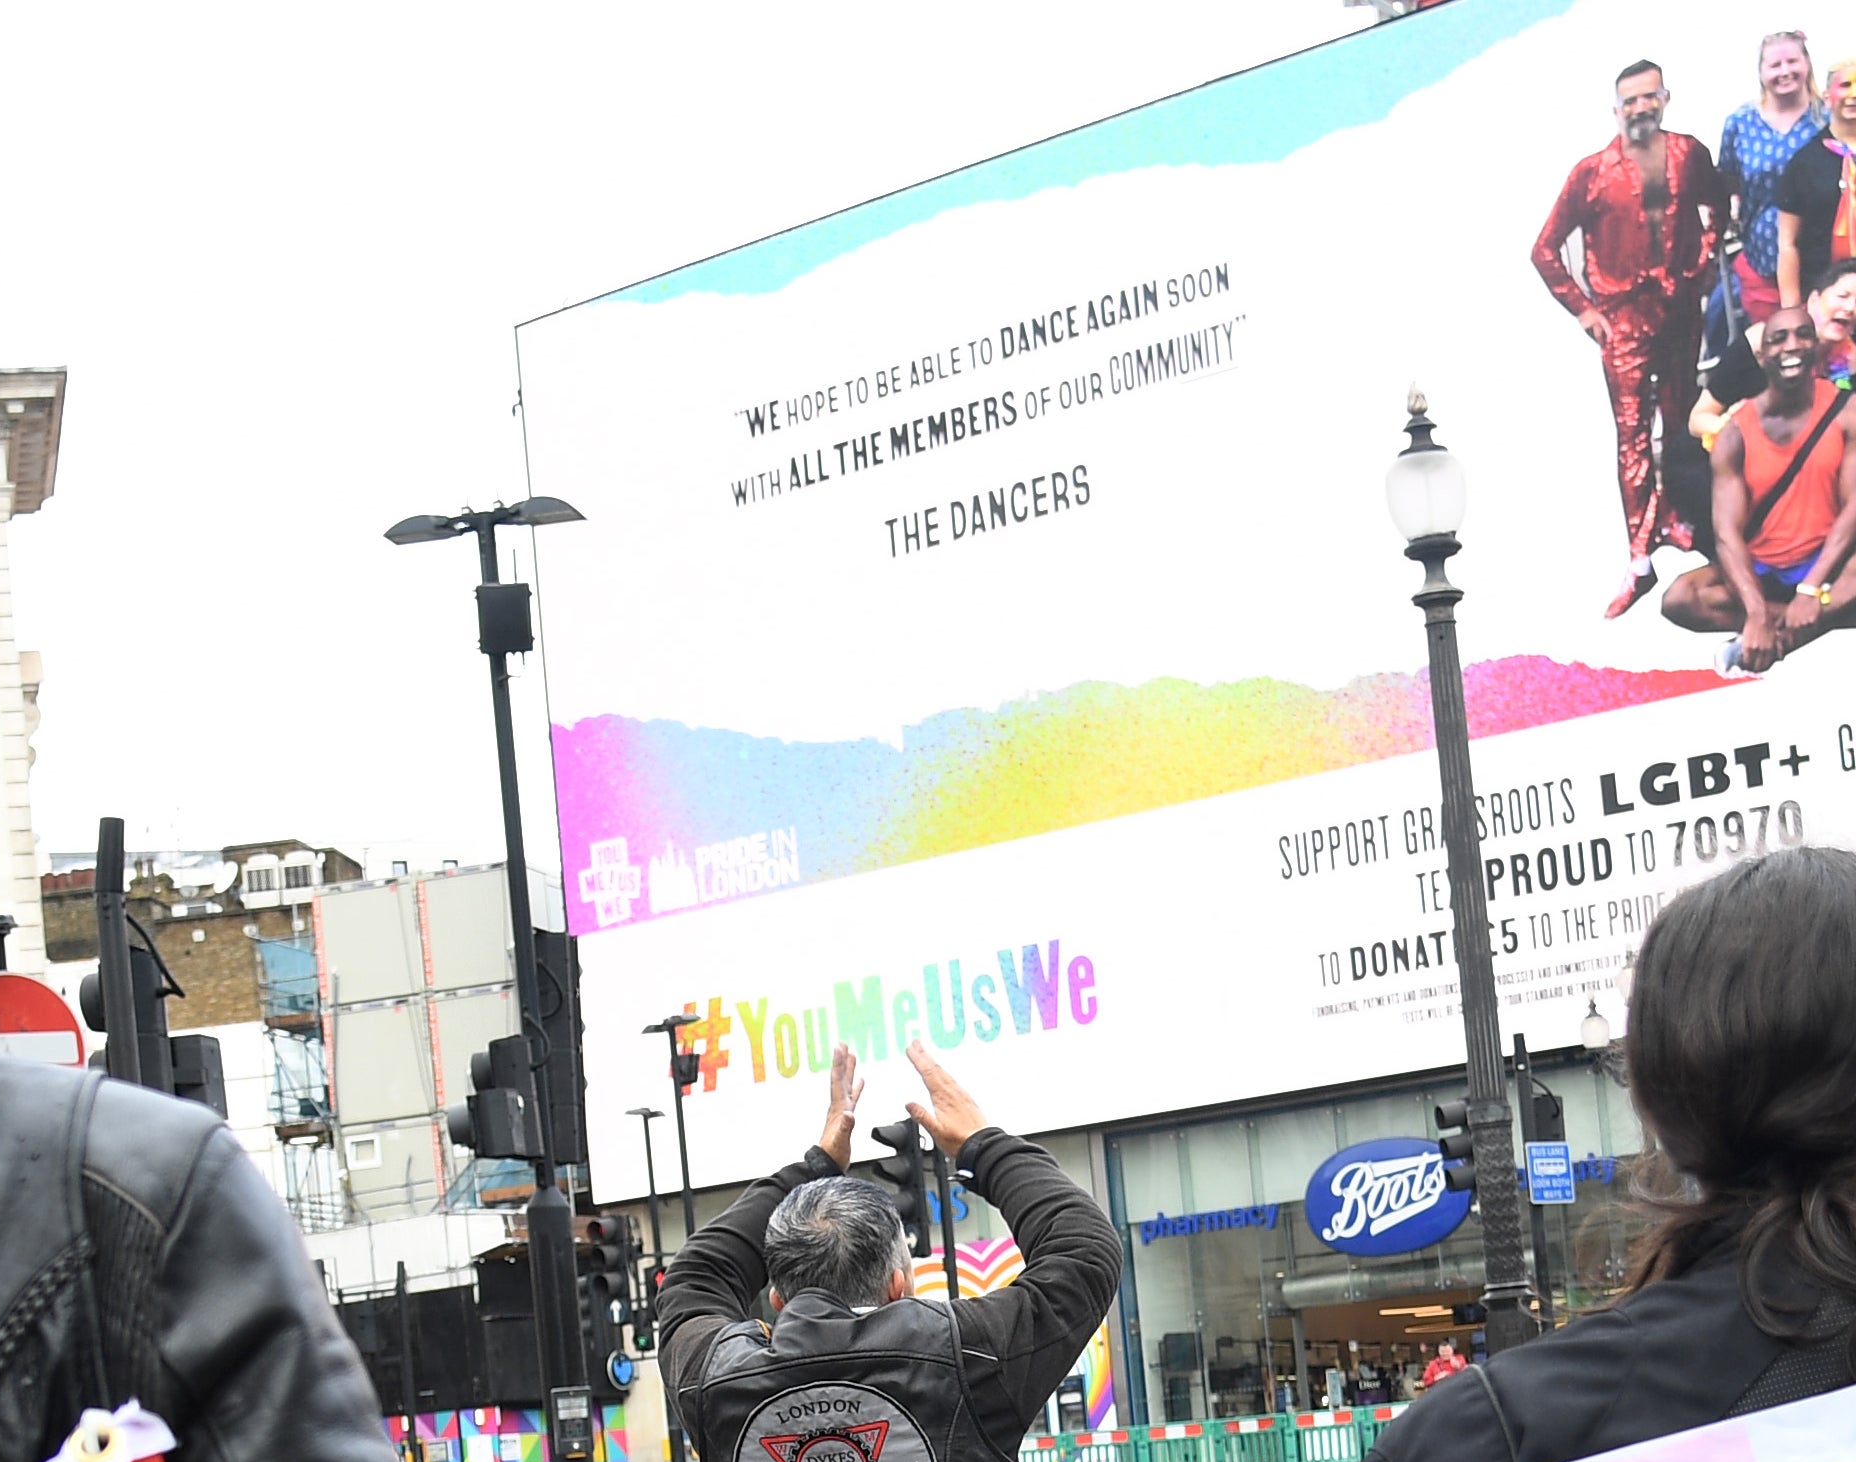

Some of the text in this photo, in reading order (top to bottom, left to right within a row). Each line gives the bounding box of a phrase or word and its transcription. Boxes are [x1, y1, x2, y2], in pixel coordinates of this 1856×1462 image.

[787, 385, 839, 427] HOPE
[845, 376, 869, 409] TO
[876, 364, 902, 399] BE
[909, 346, 962, 390] ABLE
[968, 338, 994, 370] TO
[1000, 305, 1080, 360] DANCE
[1086, 281, 1159, 335] AGAIN
[1167, 262, 1230, 308] SOON
[731, 468, 782, 508] WITH
[789, 449, 830, 492] ALL
[834, 432, 884, 476] THE
[890, 391, 1018, 461] MEMBERS
[1024, 386, 1052, 421] OF
[1059, 372, 1104, 410] OUR
[885, 464, 1091, 558] THE DANCERS
[695, 825, 797, 869] PRIDE IN
[1279, 815, 1389, 880] SUPPORT
[1404, 778, 1575, 855] GRSROOTS
[1600, 742, 1810, 817] LGBT+
[1485, 837, 1612, 901] PROUD
[1626, 829, 1655, 875] TO
[1666, 800, 1804, 868] 70970
[697, 854, 800, 902] LONDON
[1318, 951, 1341, 987] TO
[1350, 931, 1447, 981] DONAT
[1529, 912, 1552, 950] TO
[1561, 904, 1599, 944] THE
[1496, 969, 1534, 986] ROCESSED
[669, 939, 1098, 1097] #YouMeUsWe
[1141, 1202, 1279, 1245] pharmacy
[1321, 1152, 1447, 1242] Boots
[776, 1399, 862, 1424] LONDON
